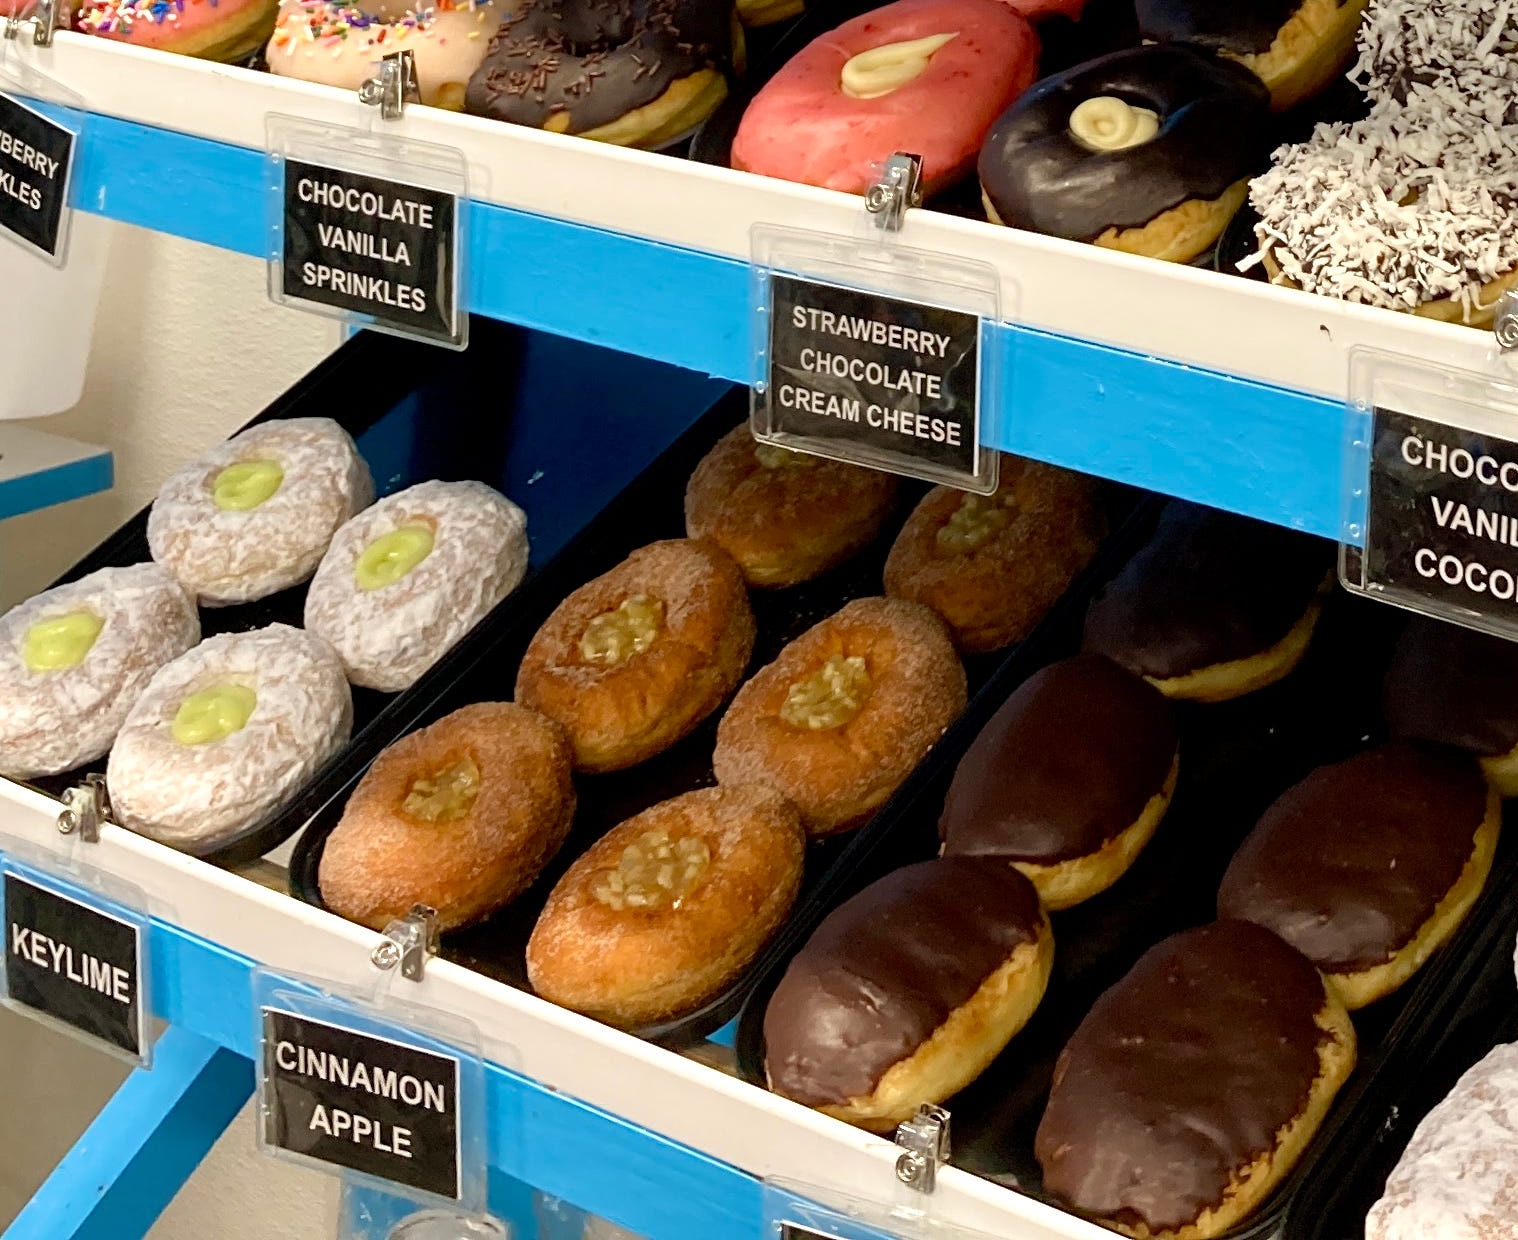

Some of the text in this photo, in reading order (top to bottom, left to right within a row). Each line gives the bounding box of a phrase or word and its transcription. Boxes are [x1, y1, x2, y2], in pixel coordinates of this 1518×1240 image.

[0, 129, 60, 180] BERRY
[298, 178, 434, 229] CHOCOLATE
[318, 222, 412, 267] VANILLA
[302, 261, 427, 312] SPRINKLES
[792, 305, 951, 358] STRAWBERRY
[800, 348, 942, 400] CHOCOLATE
[779, 384, 962, 447] CREAM CHEESE
[12, 922, 131, 1004] KEYLIME
[275, 1040, 446, 1114] CINNAMON
[309, 1103, 413, 1159] APPLE
